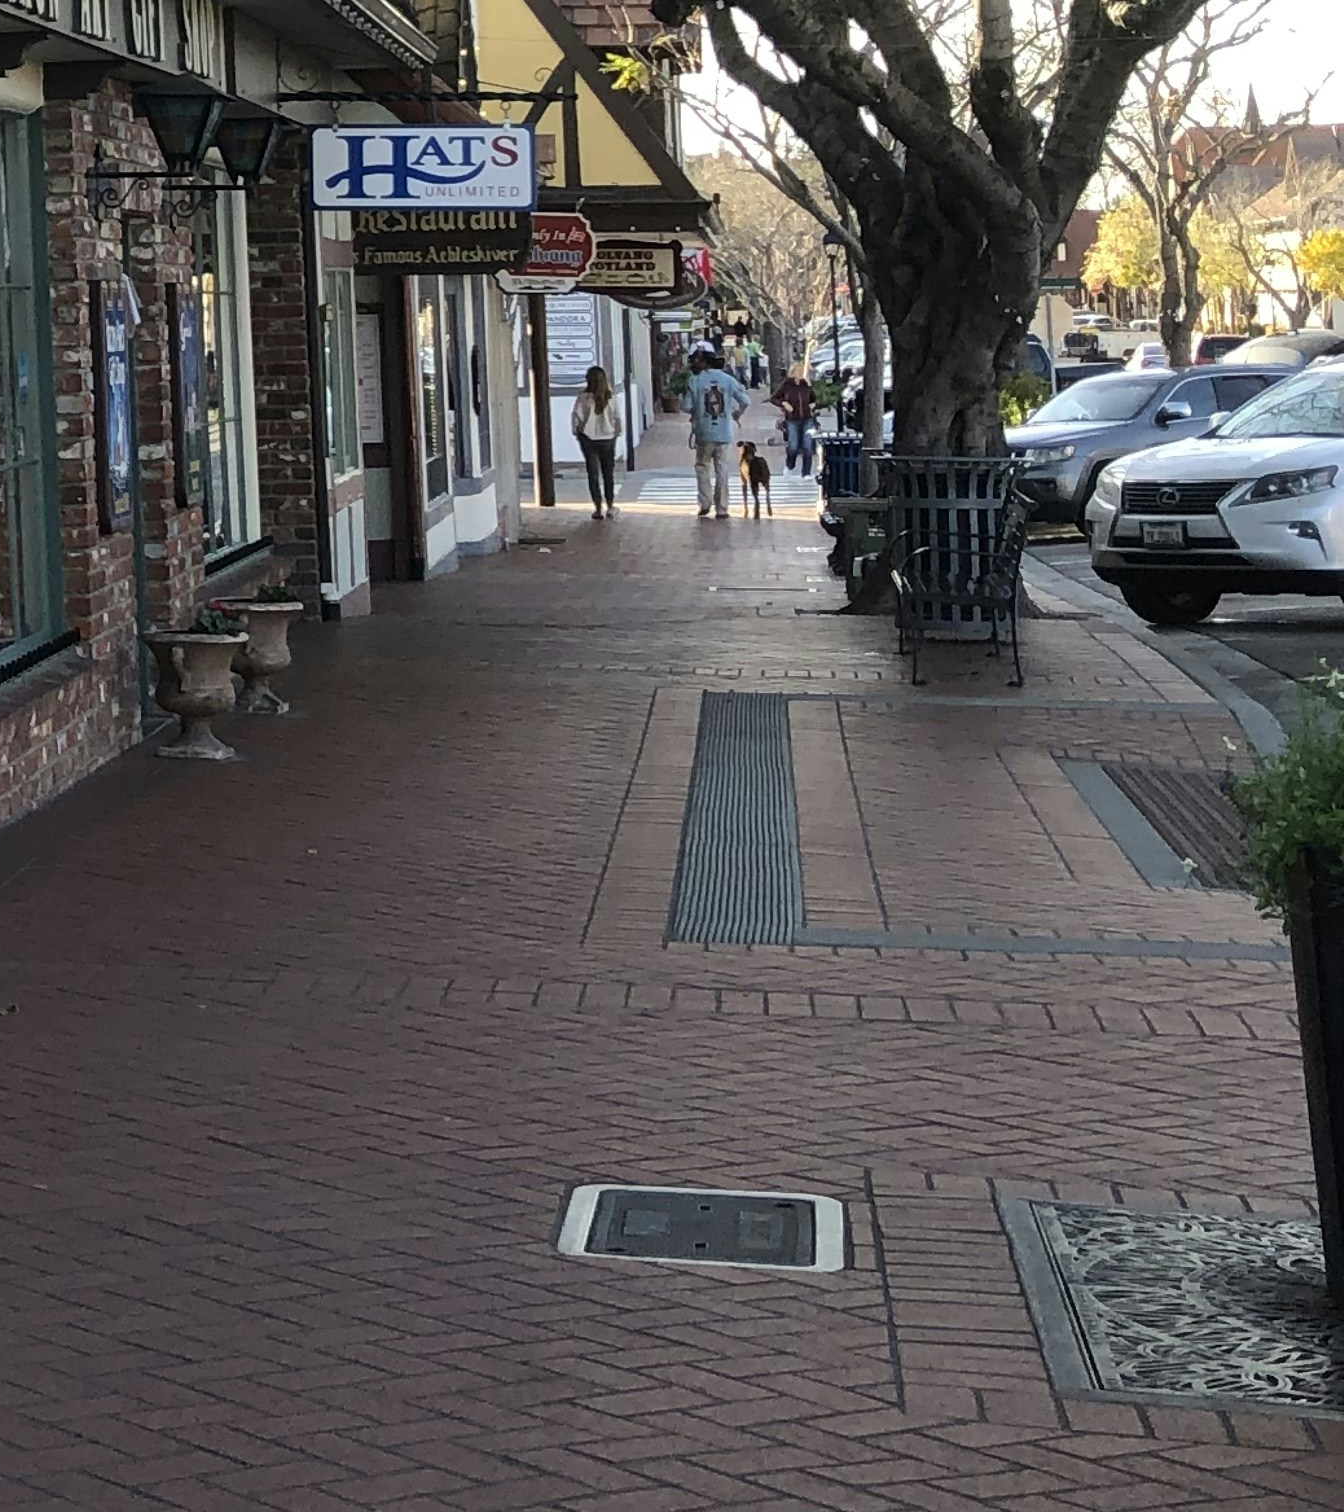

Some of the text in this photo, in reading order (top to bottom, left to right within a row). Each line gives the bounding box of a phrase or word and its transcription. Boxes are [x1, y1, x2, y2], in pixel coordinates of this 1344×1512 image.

[325, 135, 519, 199] HATS
[425, 185, 520, 198] UNLIMITED
[364, 246, 423, 265] Famous
[596, 250, 654, 260] OLVANG
